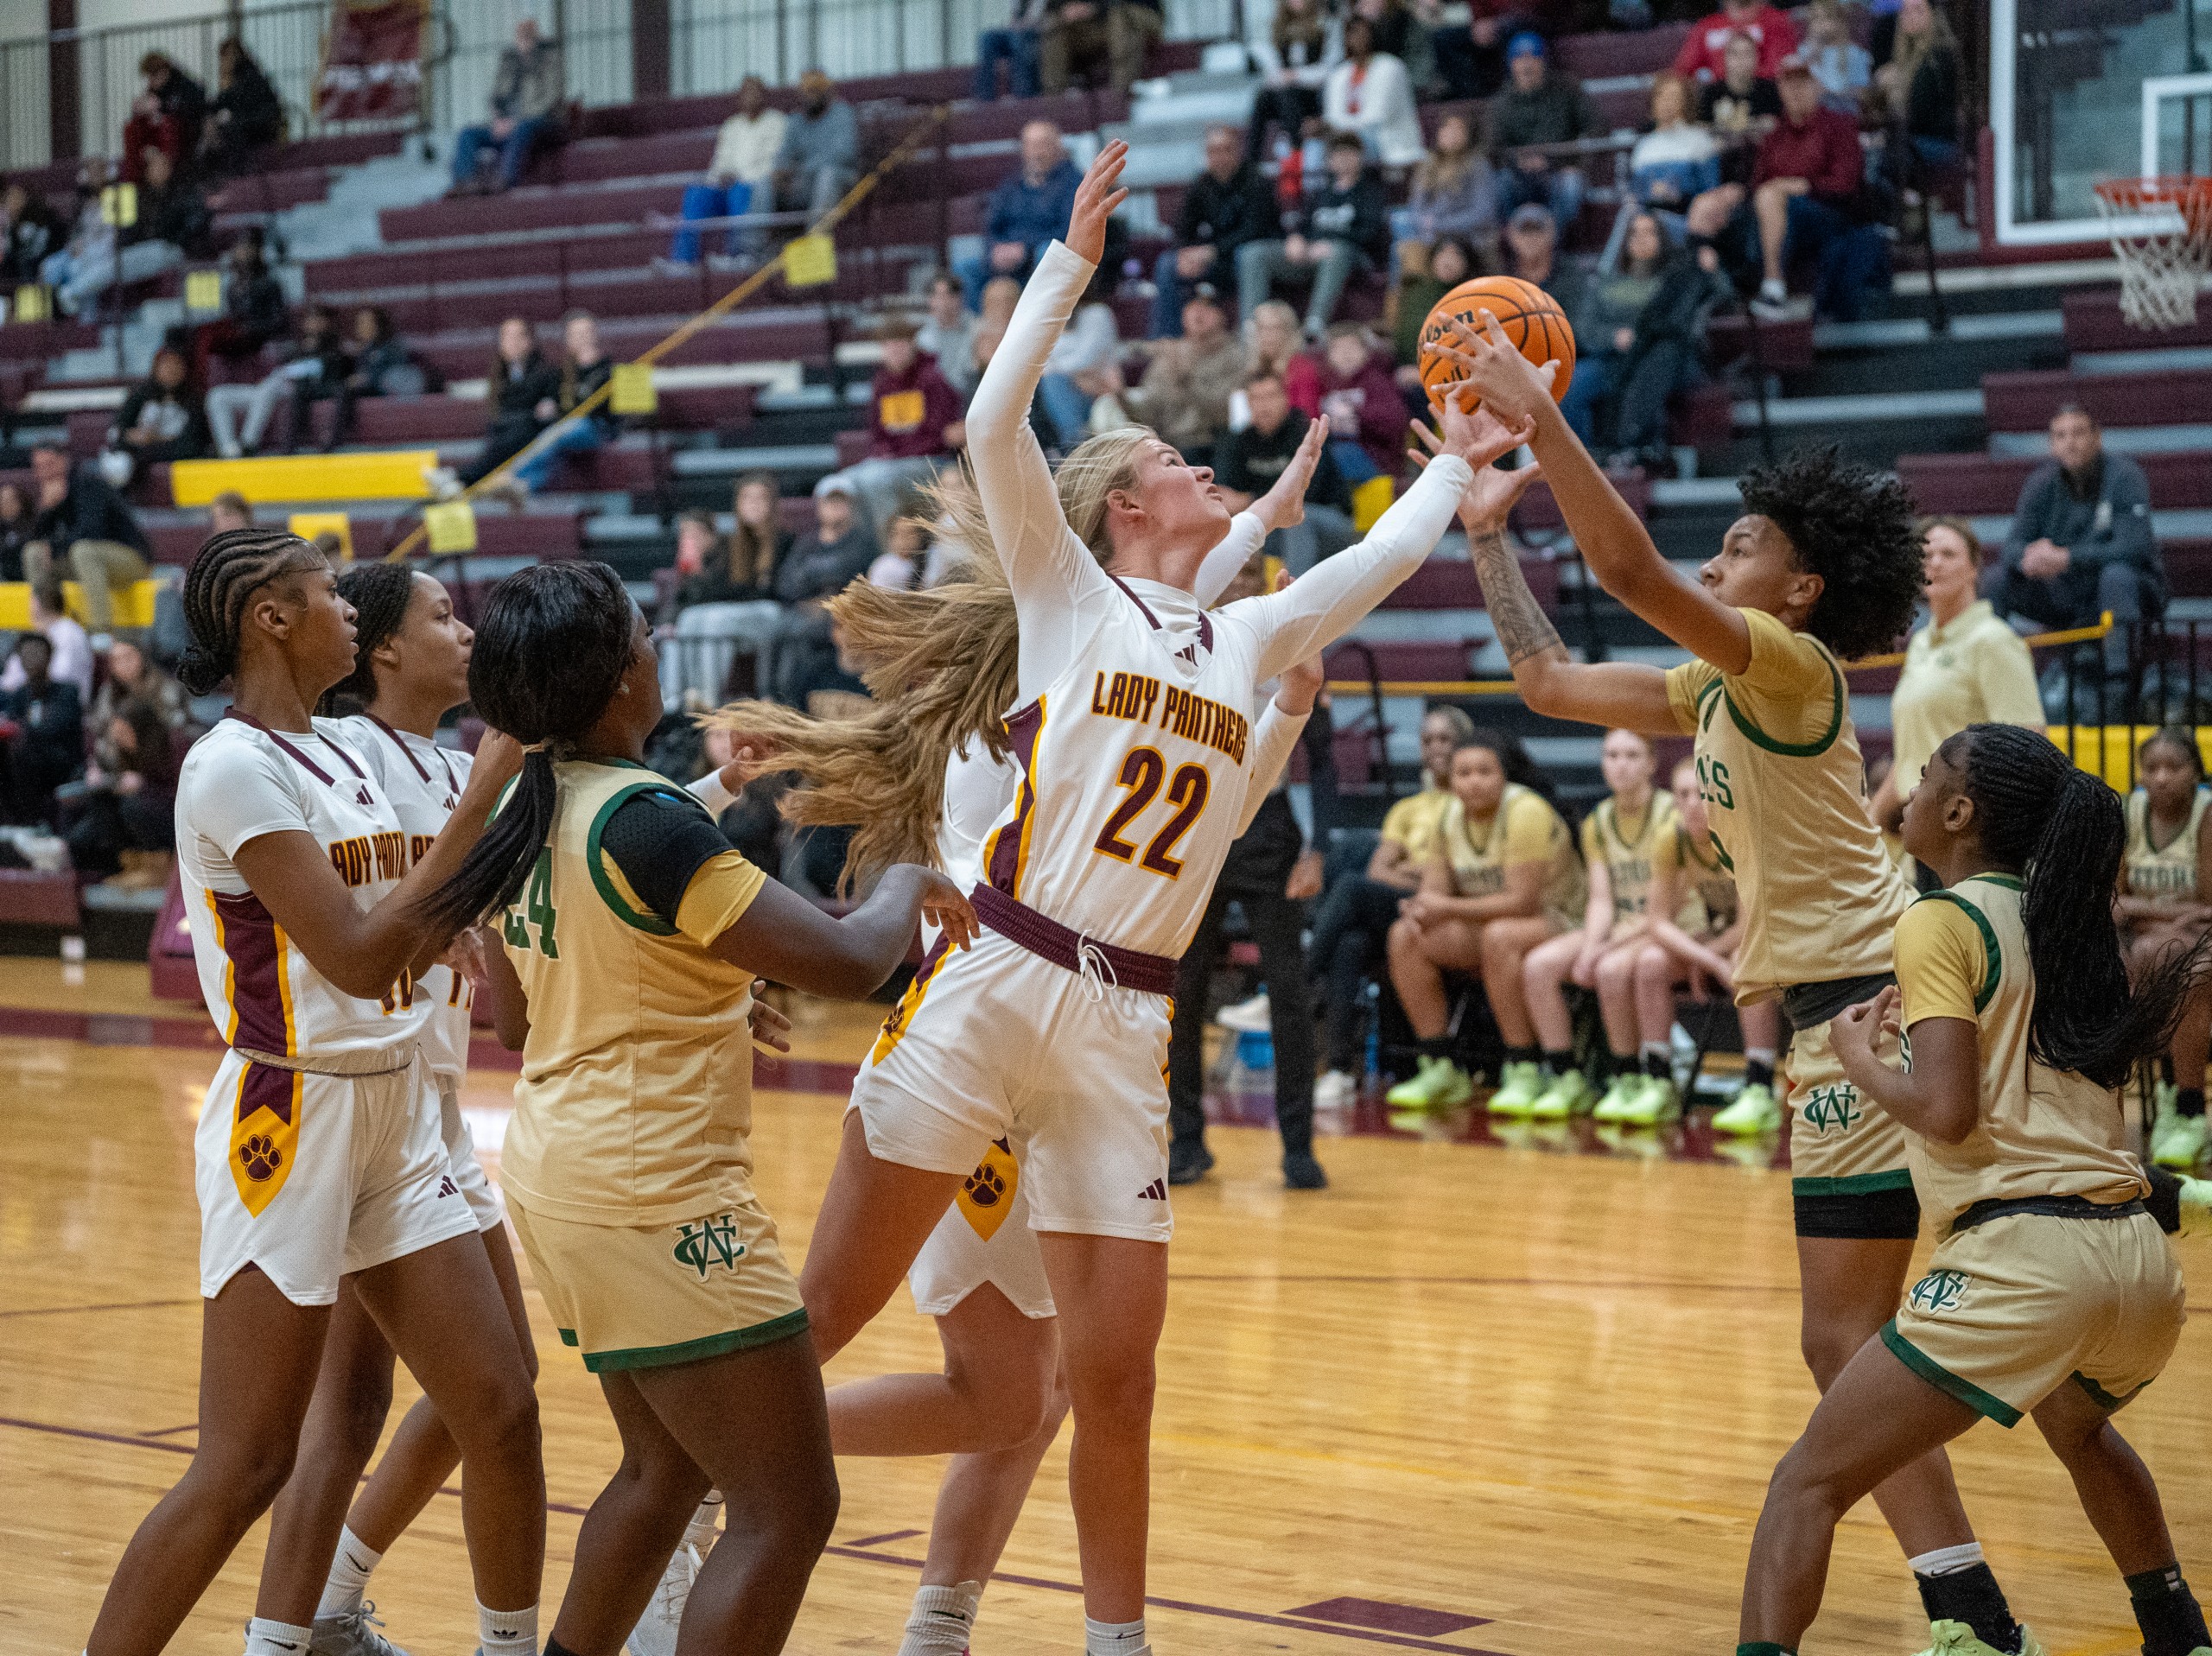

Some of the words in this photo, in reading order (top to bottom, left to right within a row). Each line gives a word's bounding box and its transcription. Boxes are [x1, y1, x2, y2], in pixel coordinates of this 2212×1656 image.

[1090, 670, 1160, 725] LADY
[1160, 683, 1249, 767] PANTHERS
[329, 835, 372, 888] ADY
[1093, 745, 1211, 881] 22
